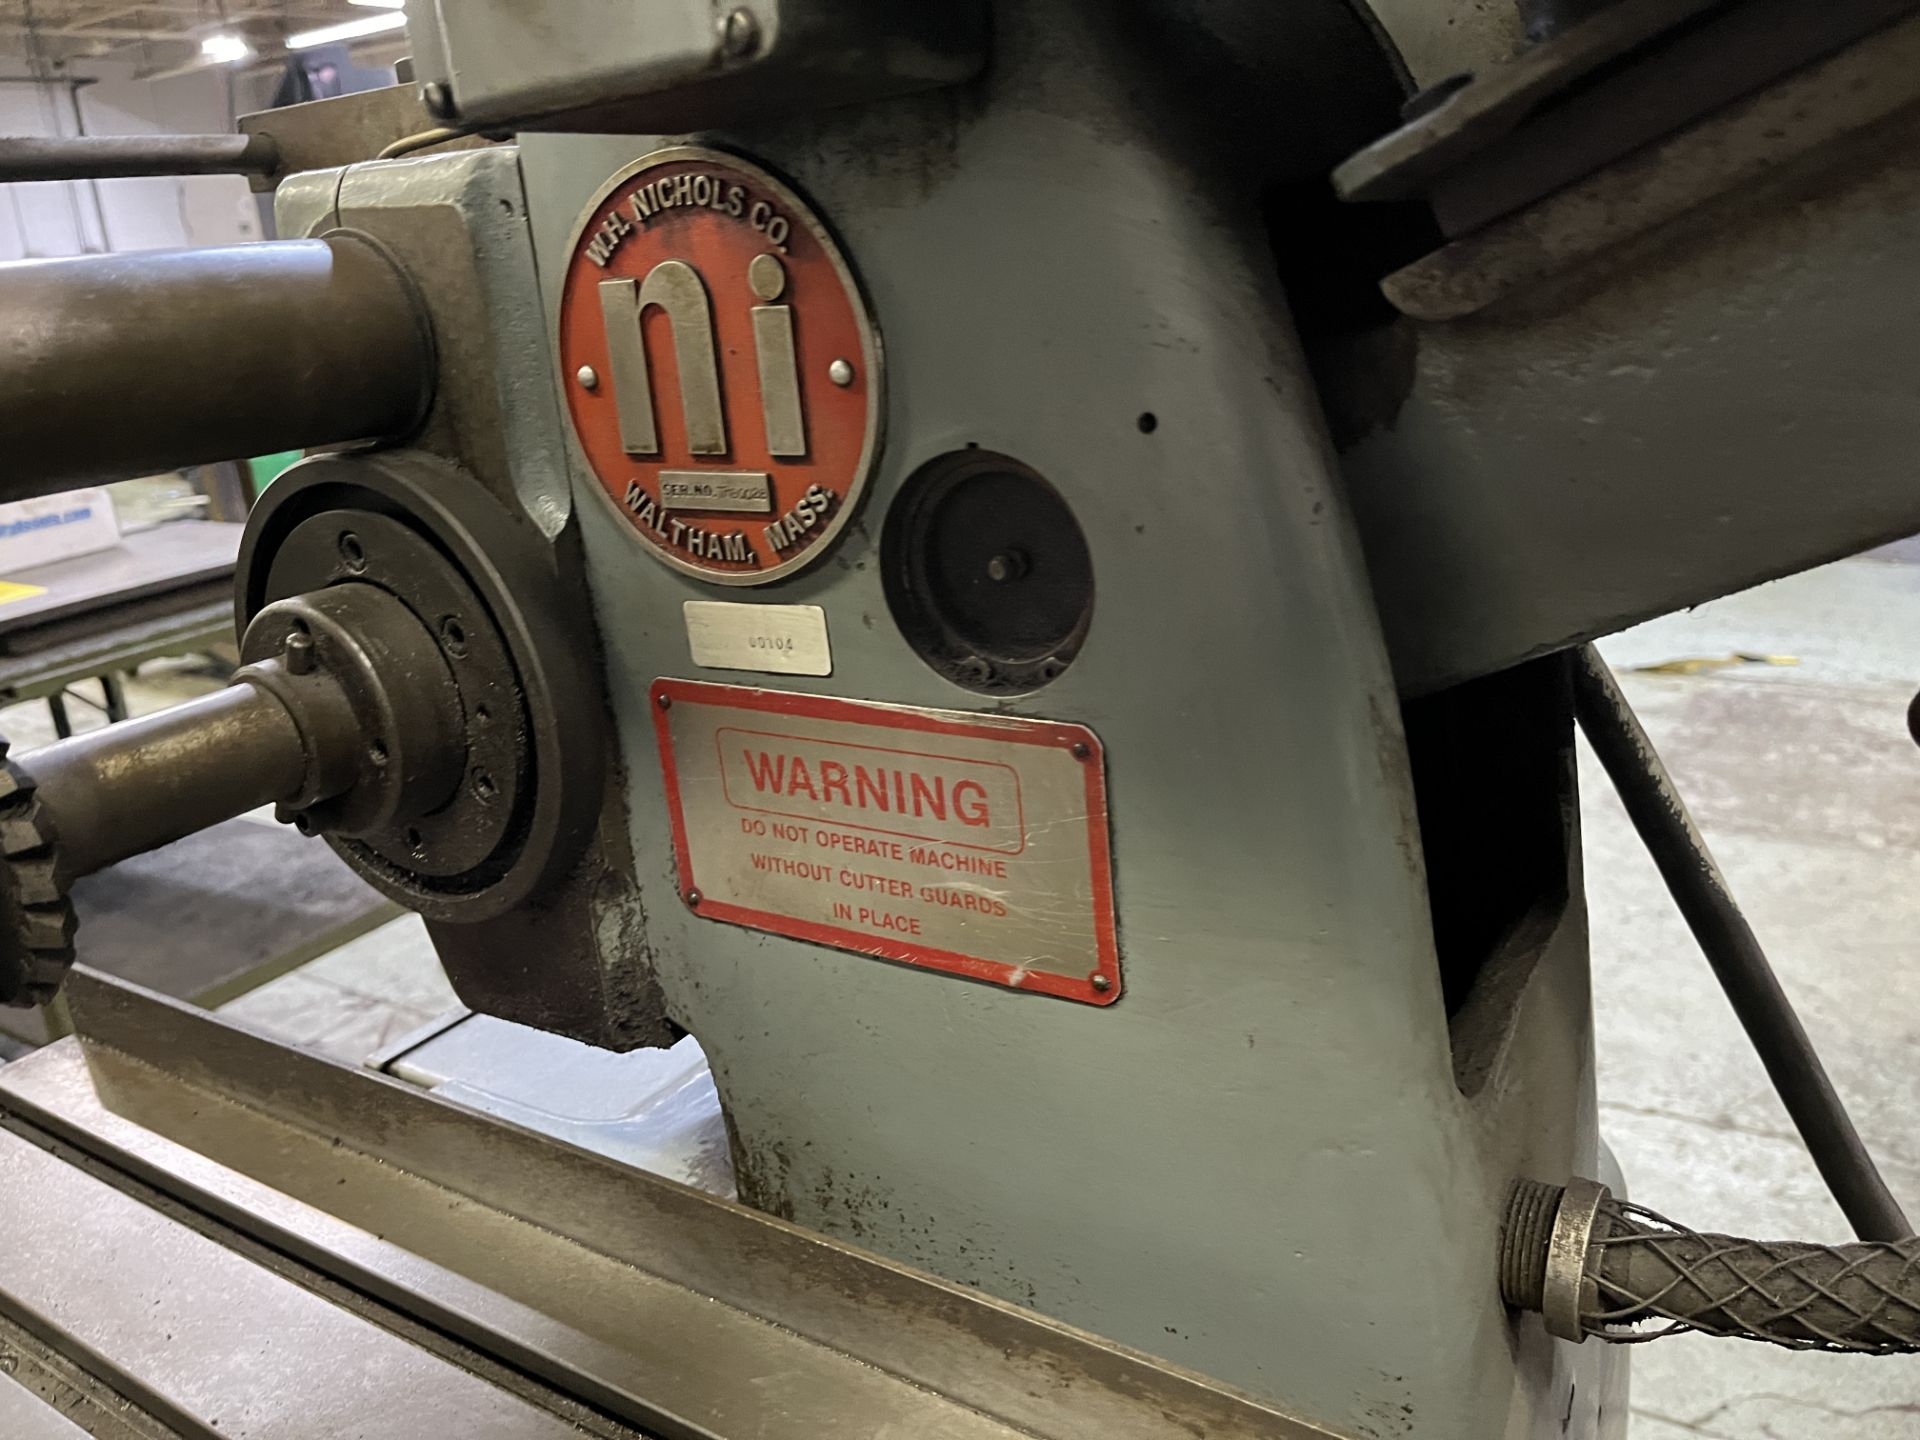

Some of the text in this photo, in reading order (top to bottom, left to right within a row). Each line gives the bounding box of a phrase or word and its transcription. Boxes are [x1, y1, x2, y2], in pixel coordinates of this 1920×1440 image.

[585, 173, 791, 269] W.H. NICHOLS CO.
[623, 480, 838, 564] WALTHAM, MASS.
[743, 749, 991, 828] WARNING
[741, 817, 1008, 879] DO NOT OPERATE MACHINE
[750, 853, 1008, 918] WITHOUT CUTTER GUARDS
[833, 902, 922, 935] IN PLACE
